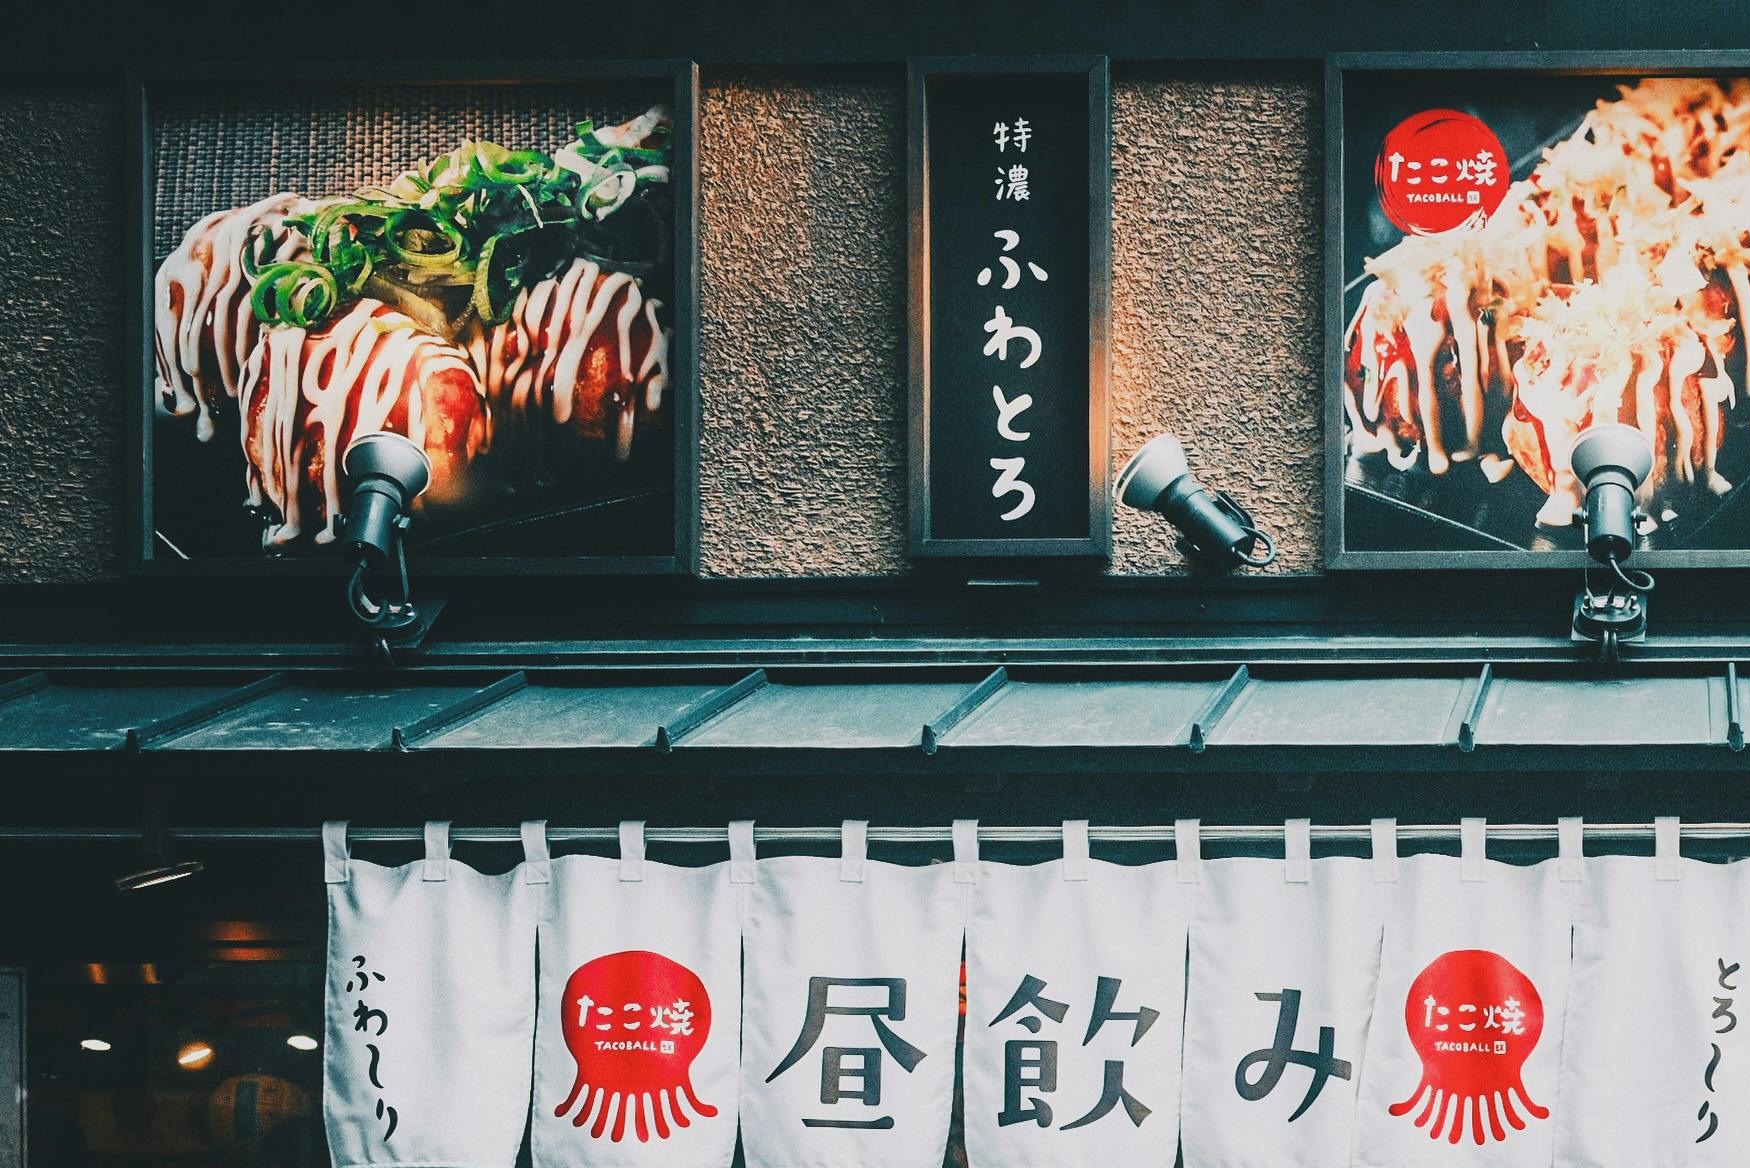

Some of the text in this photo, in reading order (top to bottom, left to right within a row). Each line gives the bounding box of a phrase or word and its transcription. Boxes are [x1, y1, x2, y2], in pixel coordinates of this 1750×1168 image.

[1388, 148, 1498, 187] たこ焼
[1405, 192, 1464, 204] TACOBALL
[977, 117, 1049, 521] 特濃 ふわとろ
[576, 994, 695, 1036] たこ焼
[1423, 994, 1526, 1036] たこ焼
[594, 1040, 658, 1052] TACOBALL
[1434, 1040, 1491, 1053] TACOBALL
